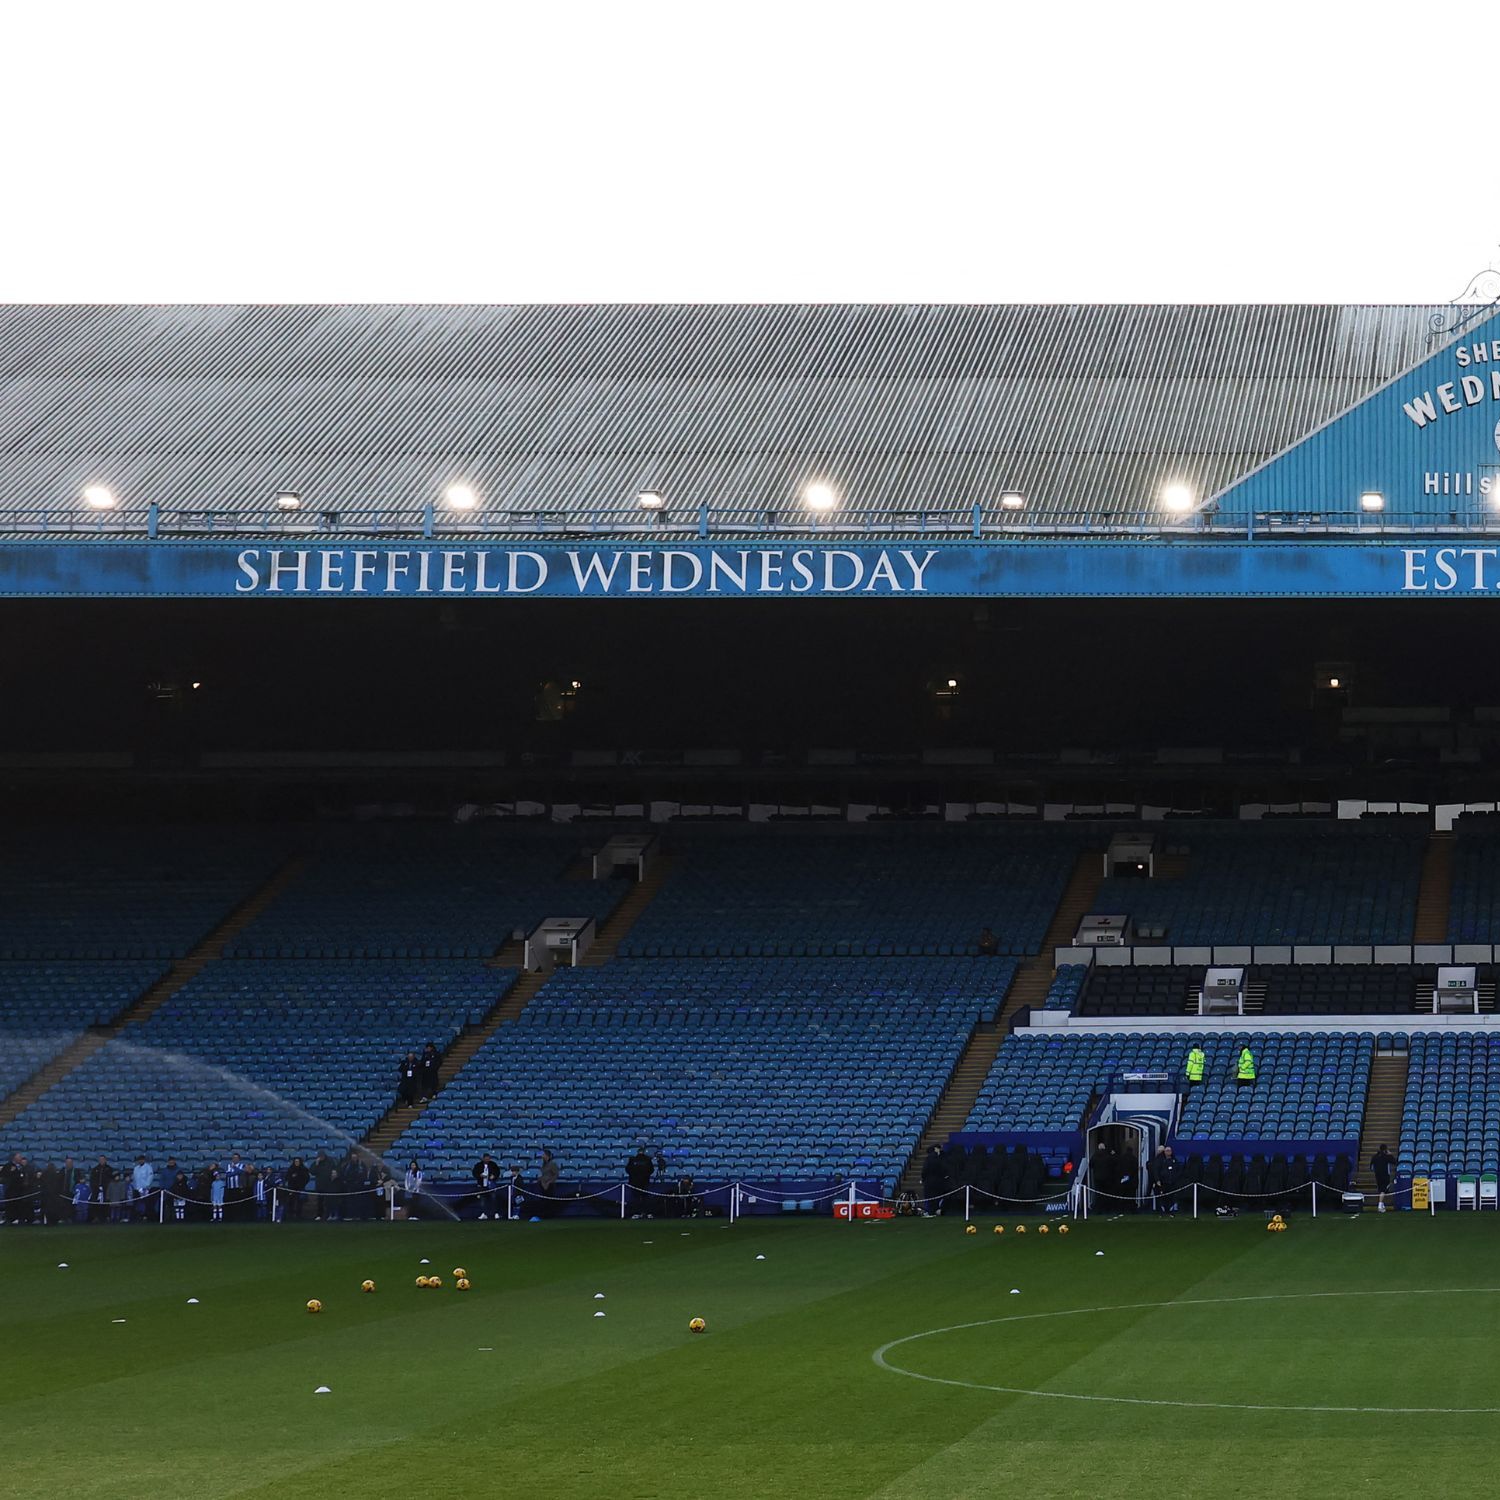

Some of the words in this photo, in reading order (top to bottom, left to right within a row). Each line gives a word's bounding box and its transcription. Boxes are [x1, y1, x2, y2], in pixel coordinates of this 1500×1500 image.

[235, 549, 548, 592] SHEFFIELD
[565, 549, 940, 593] WEDNESDAY
[839, 1206, 848, 1216] G
[862, 1206, 871, 1216] G
[1045, 1202, 1068, 1212] AWAY
